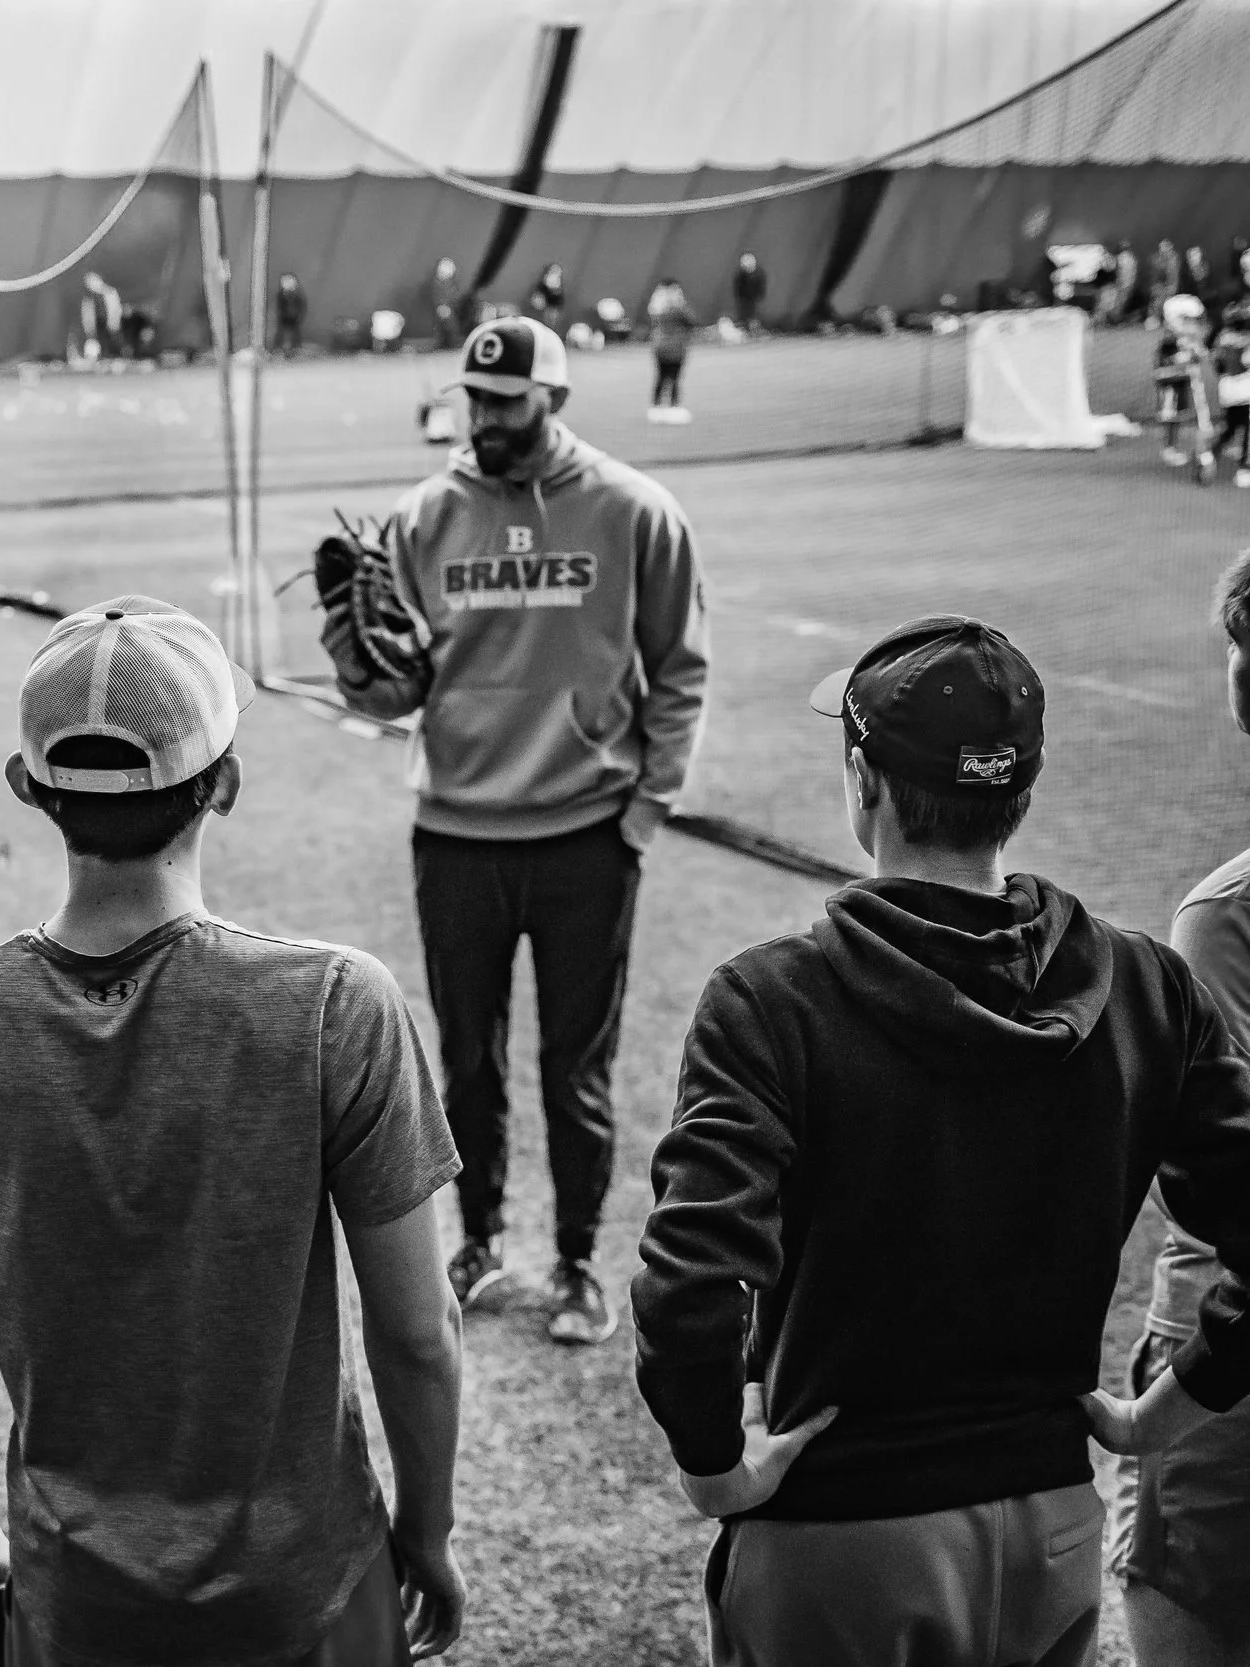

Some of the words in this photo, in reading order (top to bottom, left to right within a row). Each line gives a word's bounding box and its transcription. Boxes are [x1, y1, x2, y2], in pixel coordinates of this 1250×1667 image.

[507, 526, 533, 553] B
[442, 554, 595, 594] BRAVES
[963, 758, 1012, 772] Rawlings
